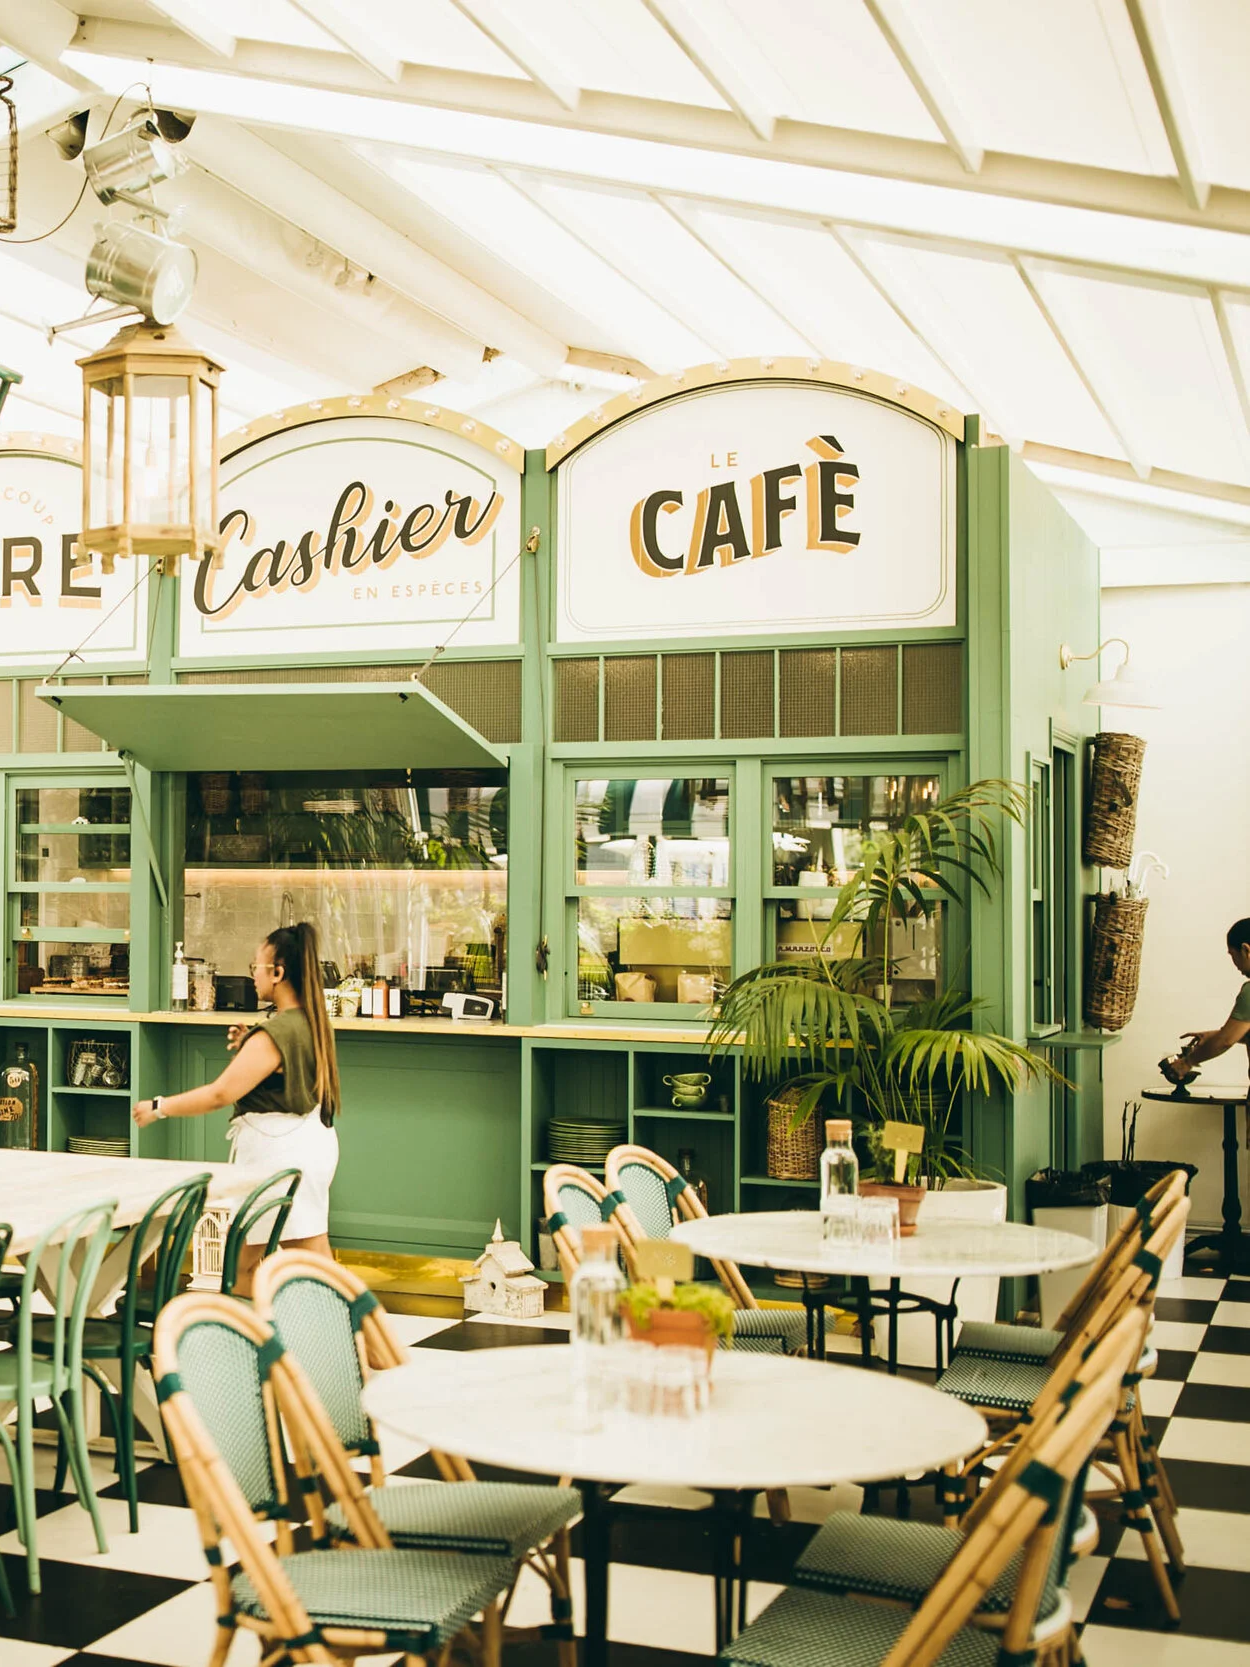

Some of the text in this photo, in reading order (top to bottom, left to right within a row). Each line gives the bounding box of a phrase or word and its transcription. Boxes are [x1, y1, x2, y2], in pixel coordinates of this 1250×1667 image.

[710, 451, 739, 468] LE
[630, 435, 861, 578] CAFÈ
[193, 481, 505, 621] Cashier
[353, 585, 379, 600] EN
